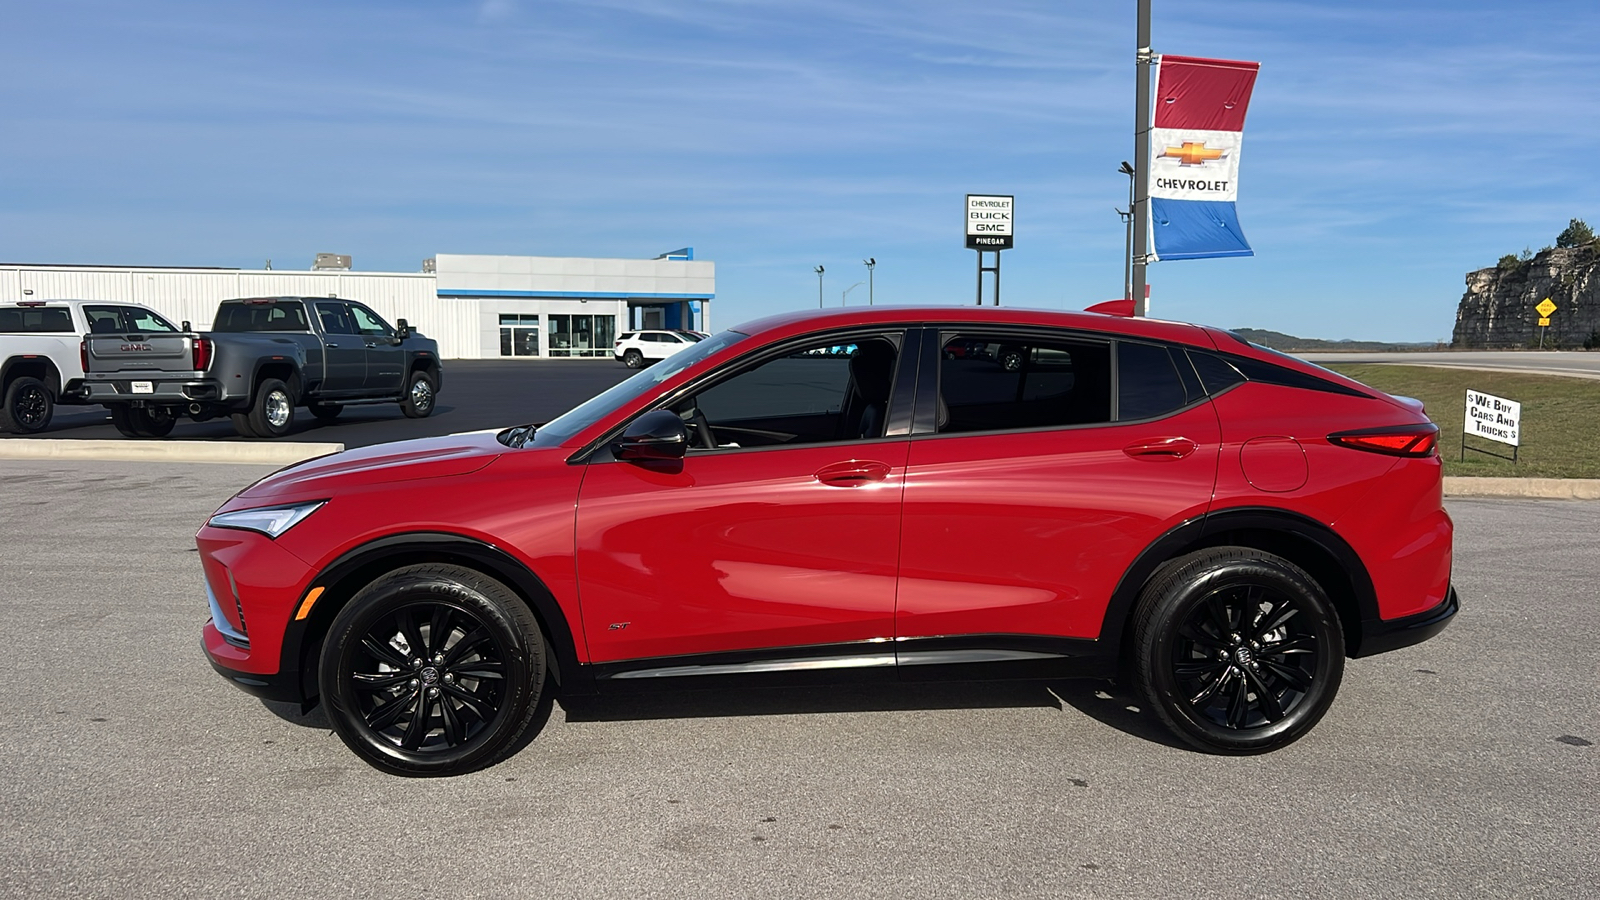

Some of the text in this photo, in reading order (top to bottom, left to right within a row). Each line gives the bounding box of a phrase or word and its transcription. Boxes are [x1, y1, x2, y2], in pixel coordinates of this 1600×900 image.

[1156, 177, 1229, 192] CHEVROLET
[971, 200, 1010, 208] CHEVROLET
[970, 212, 1010, 220] BUICK
[976, 223, 1005, 232] GMC
[975, 237, 1005, 245] PINEGAR
[120, 343, 153, 352] GMC
